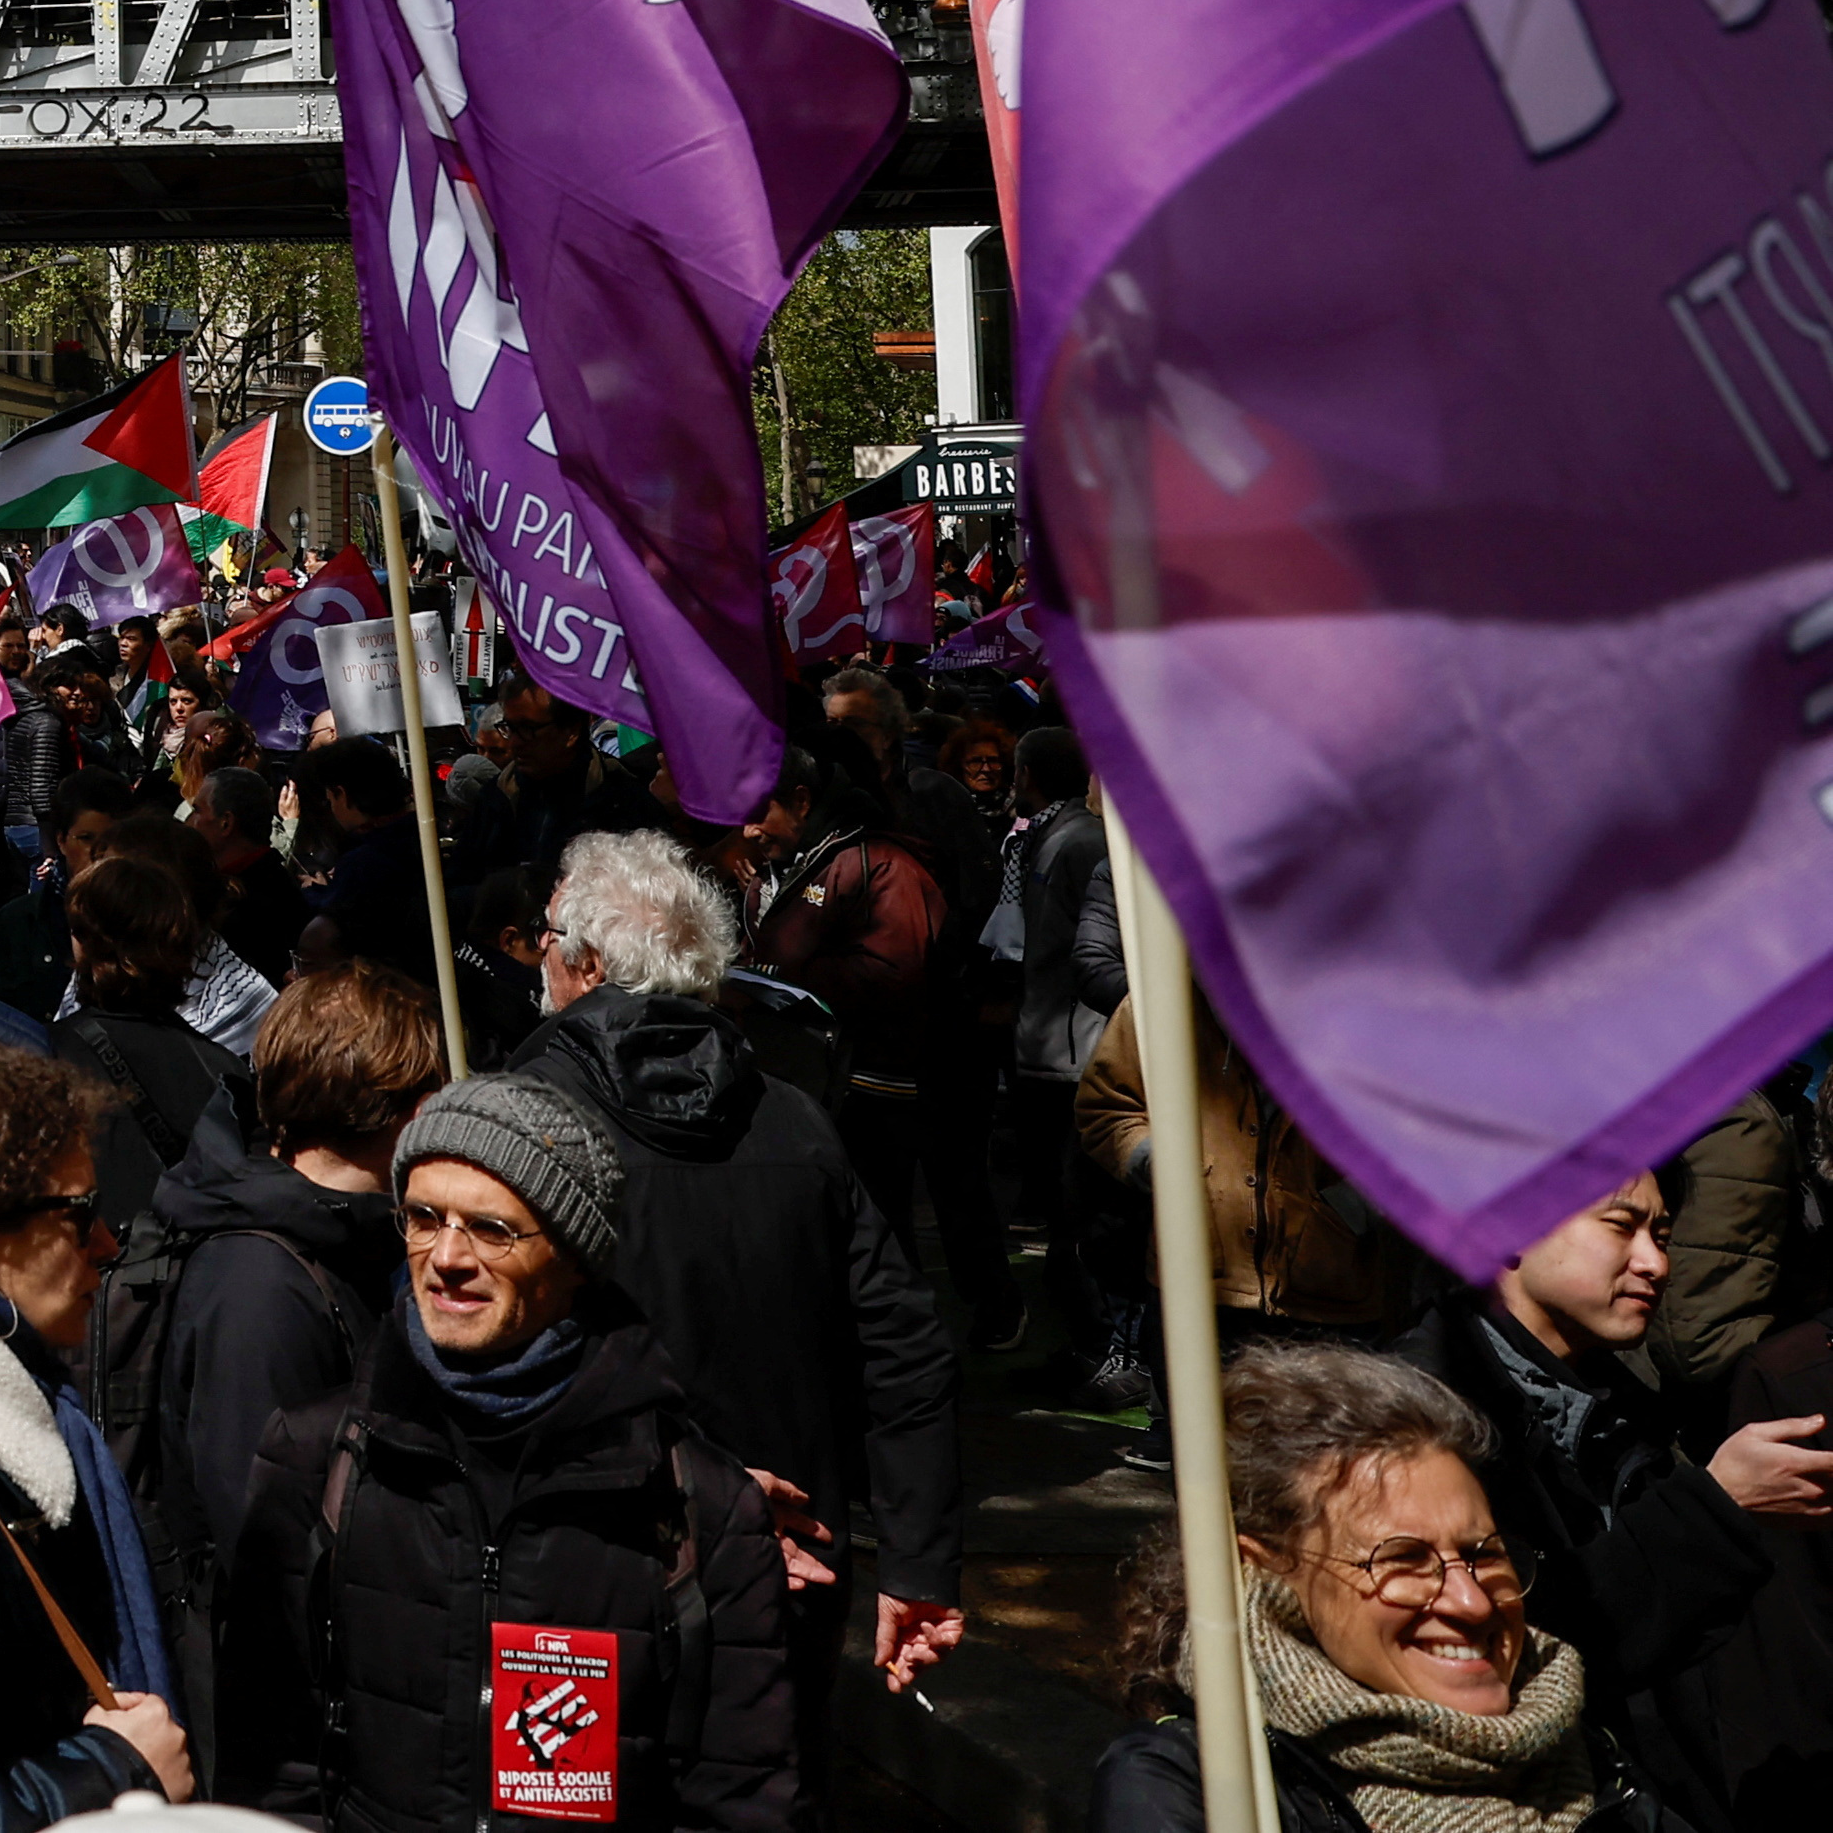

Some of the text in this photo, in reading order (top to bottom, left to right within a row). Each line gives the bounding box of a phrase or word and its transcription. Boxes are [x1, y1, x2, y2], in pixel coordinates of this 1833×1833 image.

[455, 642, 465, 683] NAVETTES
[483, 636, 492, 679] NAVETTES
[547, 1640, 569, 1653] NPA
[501, 1649, 609, 1668] LES POLITIQUES DE MACRON
[502, 1662, 537, 1673] OUVRENT
[539, 1664, 550, 1674] LA
[551, 1666, 570, 1676] VOIE
[579, 1668, 589, 1678] LE
[590, 1669, 606, 1679] PEN
[498, 1770, 612, 1786] RIPOSTE SOCIALE
[499, 1786, 612, 1802] ET ANTIFASCISTE!
